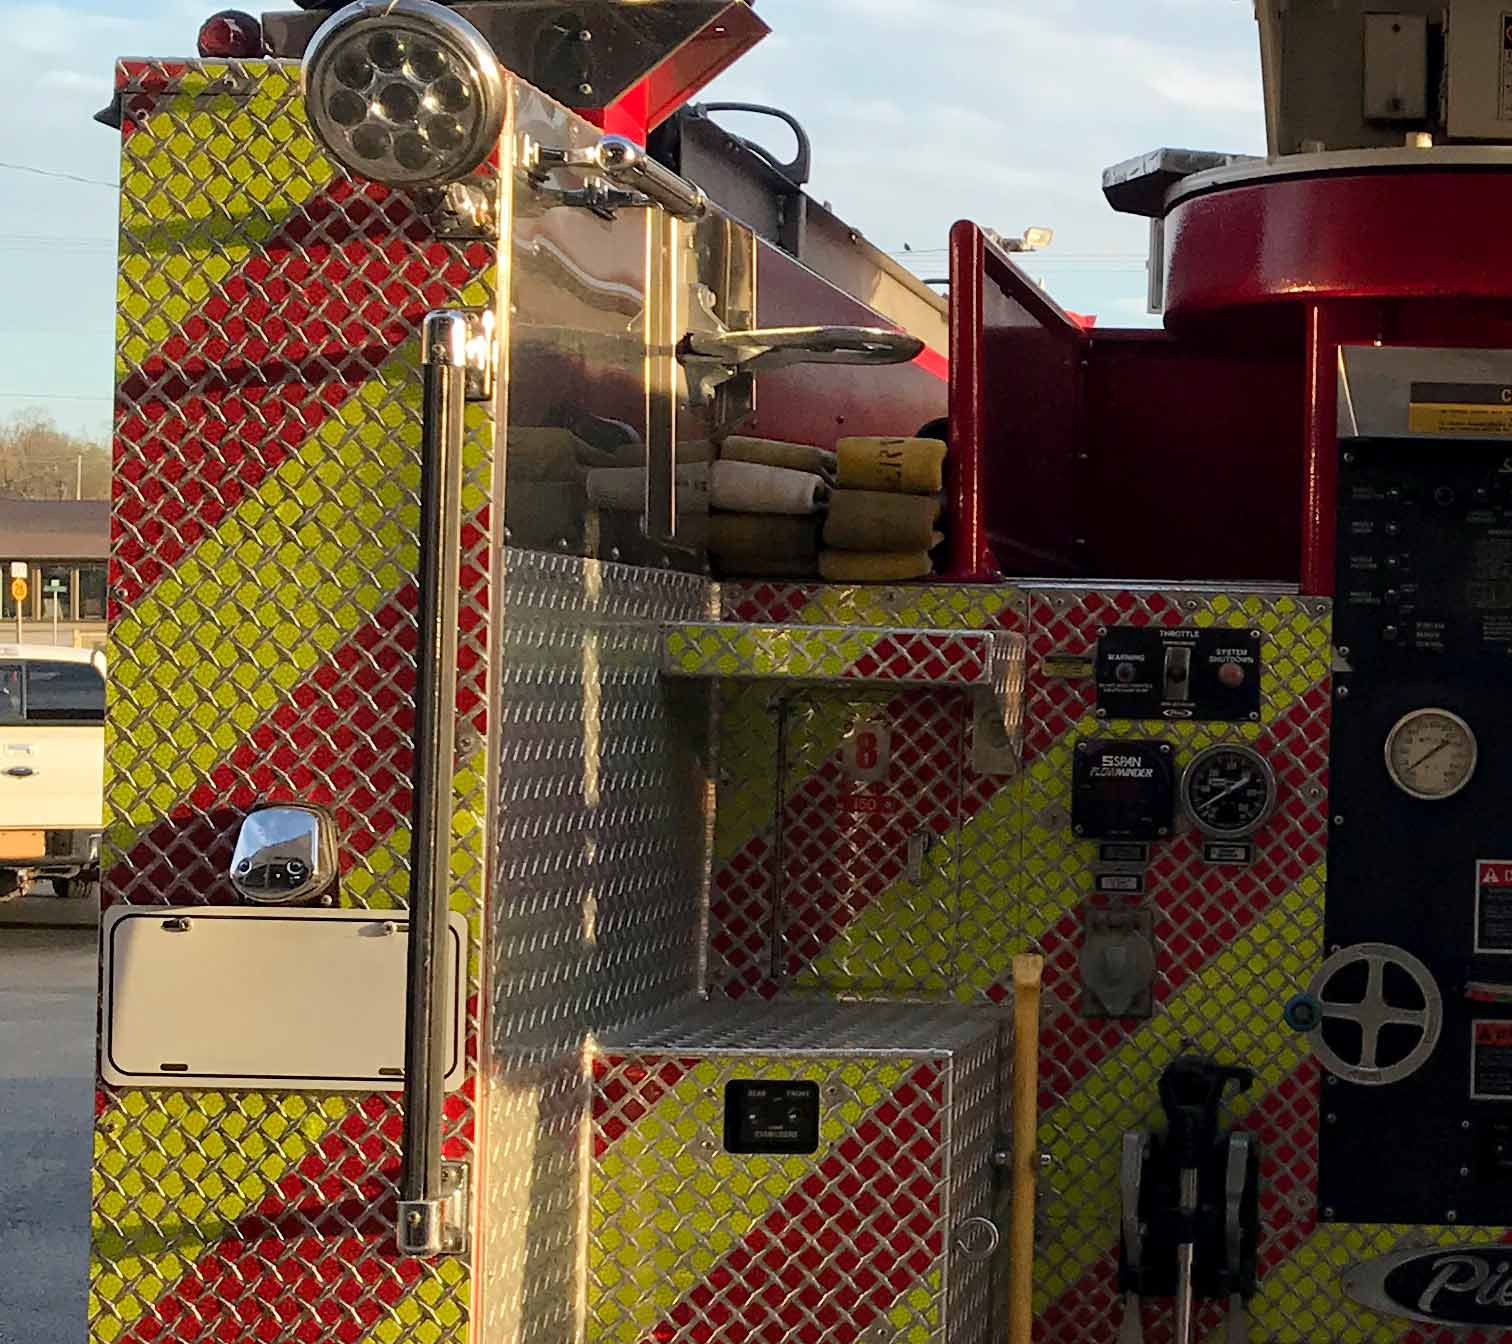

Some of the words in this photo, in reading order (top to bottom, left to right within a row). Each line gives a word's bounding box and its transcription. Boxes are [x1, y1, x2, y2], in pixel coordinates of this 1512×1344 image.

[1159, 629, 1200, 639] THROTTLE
[1215, 648, 1248, 656] SYSTEM
[1107, 653, 1145, 662] WARNING
[1208, 655, 1255, 664] SHUTDOWN
